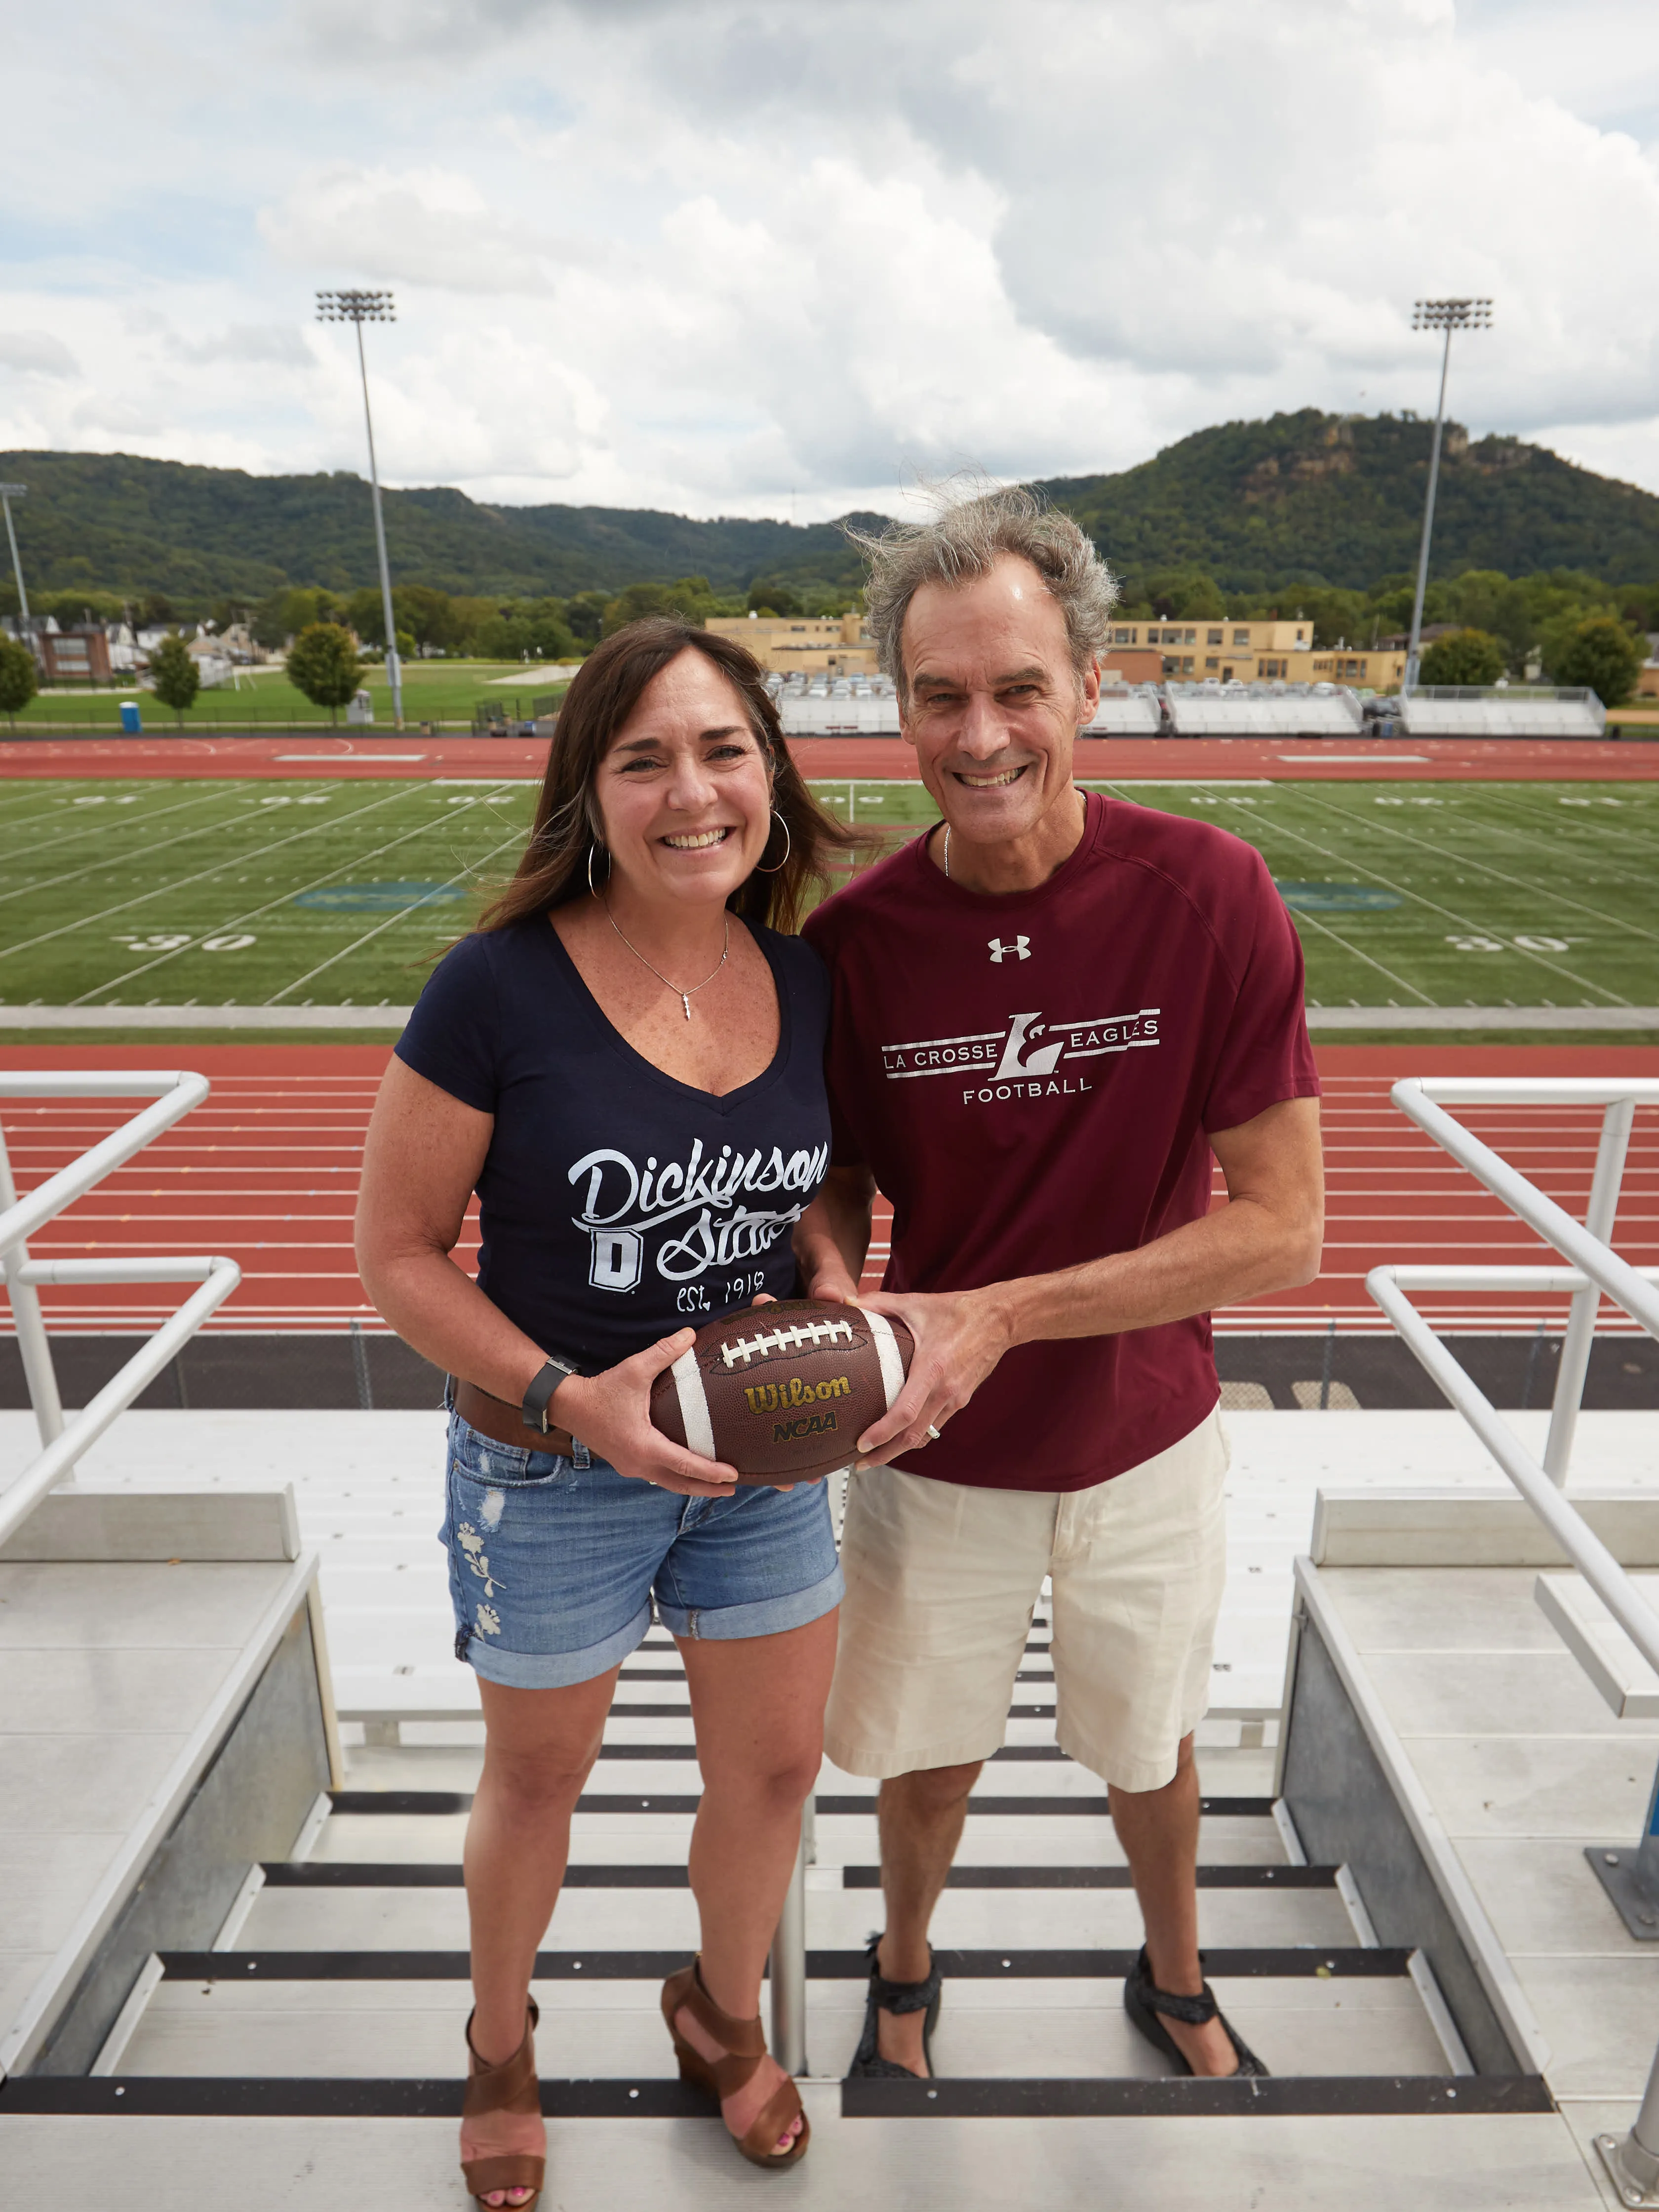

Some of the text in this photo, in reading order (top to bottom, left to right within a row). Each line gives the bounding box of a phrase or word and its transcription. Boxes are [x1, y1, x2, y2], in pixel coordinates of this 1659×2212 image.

[127, 934, 257, 952] 30
[1444, 935, 1569, 952] 30
[884, 1019, 1158, 1069] LA CROSSE EAGLES
[963, 1078, 1092, 1105] FOOTBALL
[568, 1137, 829, 1225] Dickinson
[744, 1375, 852, 1415] Wilson
[773, 1411, 838, 1443] NCAA
